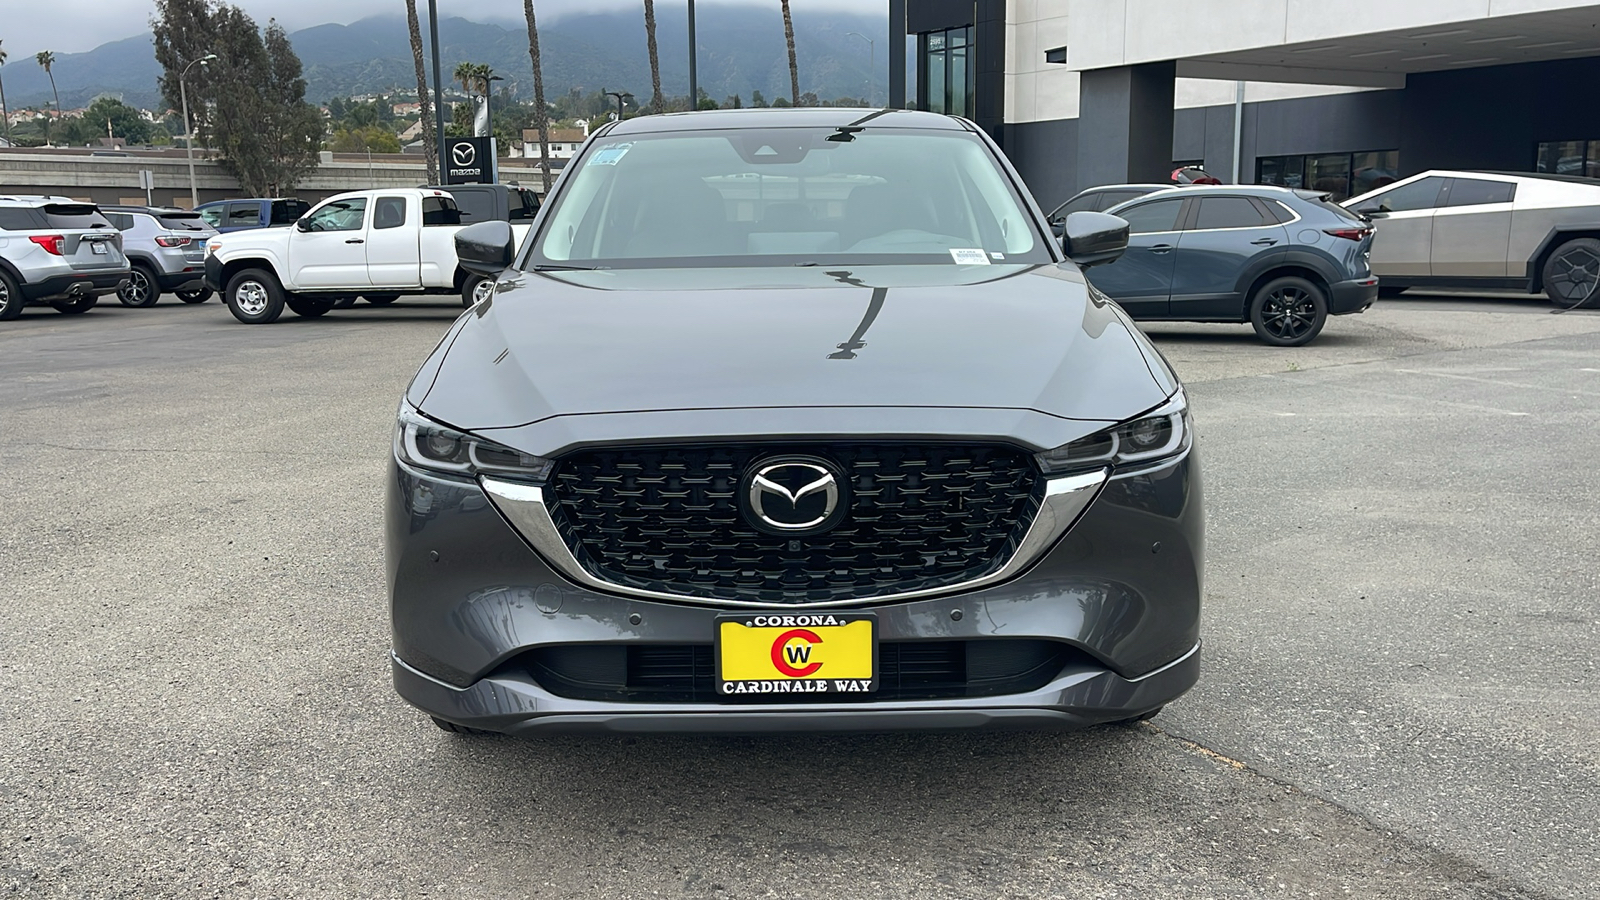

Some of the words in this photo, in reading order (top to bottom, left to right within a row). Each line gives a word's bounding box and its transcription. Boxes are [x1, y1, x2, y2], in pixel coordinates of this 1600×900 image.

[754, 615, 838, 627] CORONA
[722, 680, 828, 694] CARDINALE
[834, 680, 872, 692] WAY
